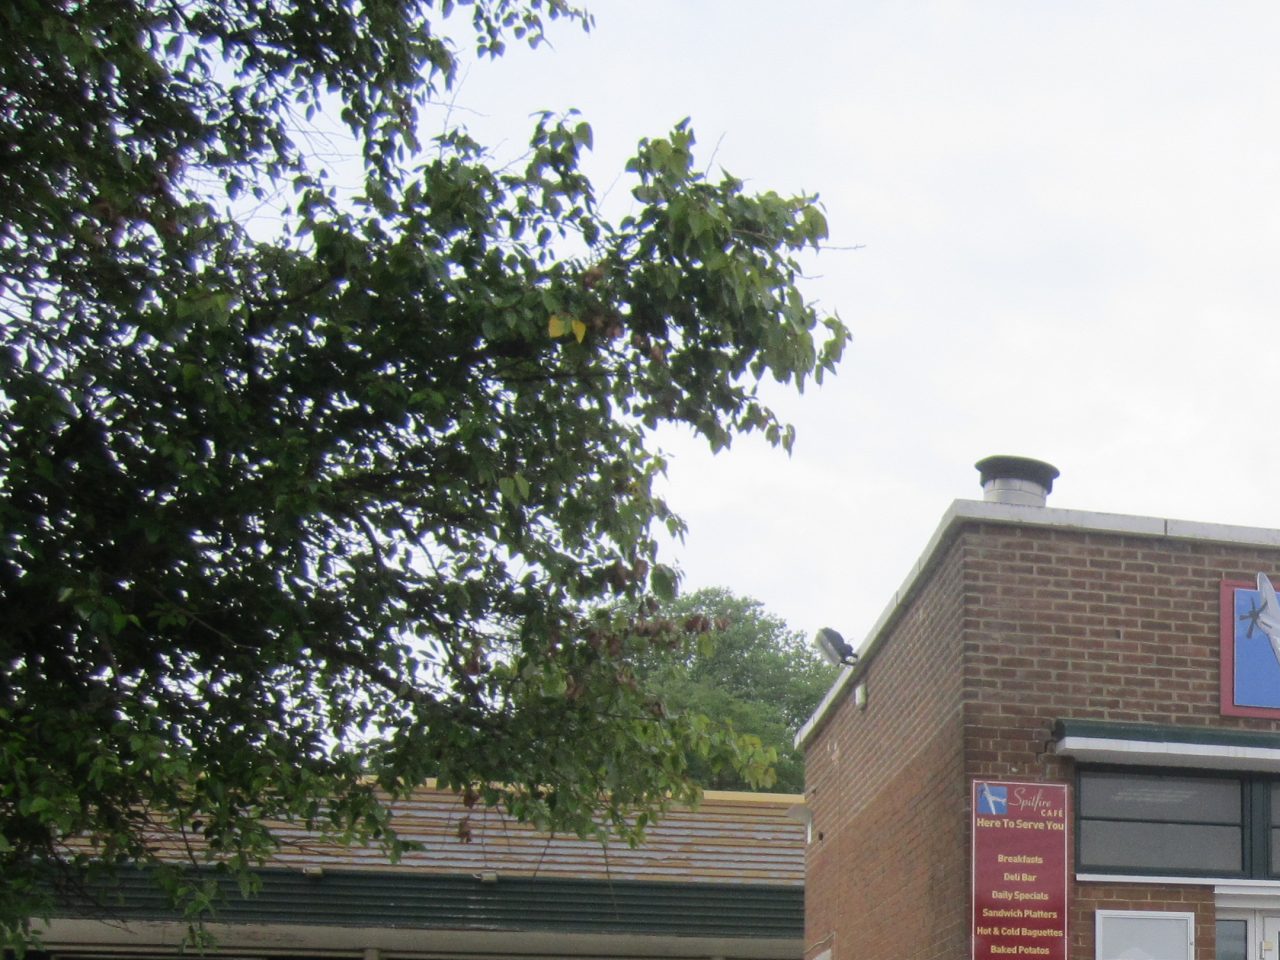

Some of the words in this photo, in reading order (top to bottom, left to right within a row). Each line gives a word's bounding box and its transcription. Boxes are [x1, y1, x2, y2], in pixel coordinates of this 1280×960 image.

[1008, 787, 1051, 811] Spitfire
[1041, 808, 1063, 817] CAFÉ
[976, 818, 1001, 828] Here
[1002, 819, 1014, 829] To
[1016, 819, 1044, 830] Serve
[1047, 820, 1064, 831] You
[997, 854, 1043, 864] Breakfasts
[1003, 873, 1020, 881] Deli
[1021, 873, 1037, 882] Bar
[991, 890, 1013, 901] Daily
[1014, 891, 1049, 902] Specials
[982, 908, 1023, 918] Sandwich
[1023, 909, 1057, 919] Platters
[976, 926, 992, 936] Hot
[992, 927, 1000, 936] &
[1001, 927, 1020, 936] Cold
[1021, 927, 1063, 938] Baguettes
[990, 945, 1017, 954] Baked
[1018, 945, 1050, 955] Potatos
